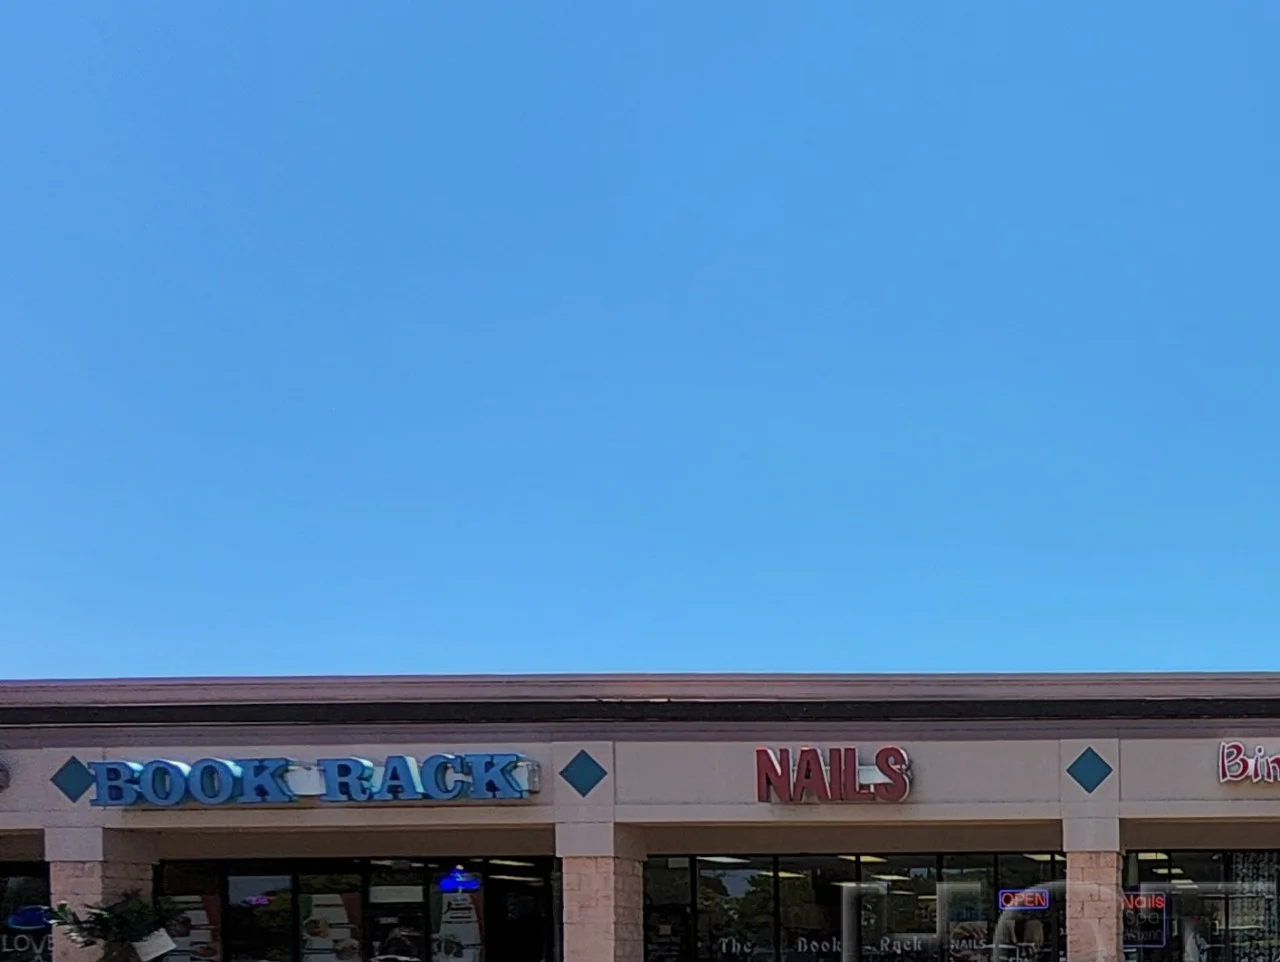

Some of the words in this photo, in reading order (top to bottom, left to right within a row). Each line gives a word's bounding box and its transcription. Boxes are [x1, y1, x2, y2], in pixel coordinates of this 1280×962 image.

[88, 757, 295, 807] BOOK
[317, 752, 530, 803] RACK
[755, 744, 912, 804] NAILS
[1001, 892, 1046, 907] OPEN
[1121, 895, 1165, 909] Nails
[1125, 910, 1160, 927] Spa
[718, 936, 753, 954] The
[797, 936, 842, 953] Book
[949, 938, 987, 950] NAILS
